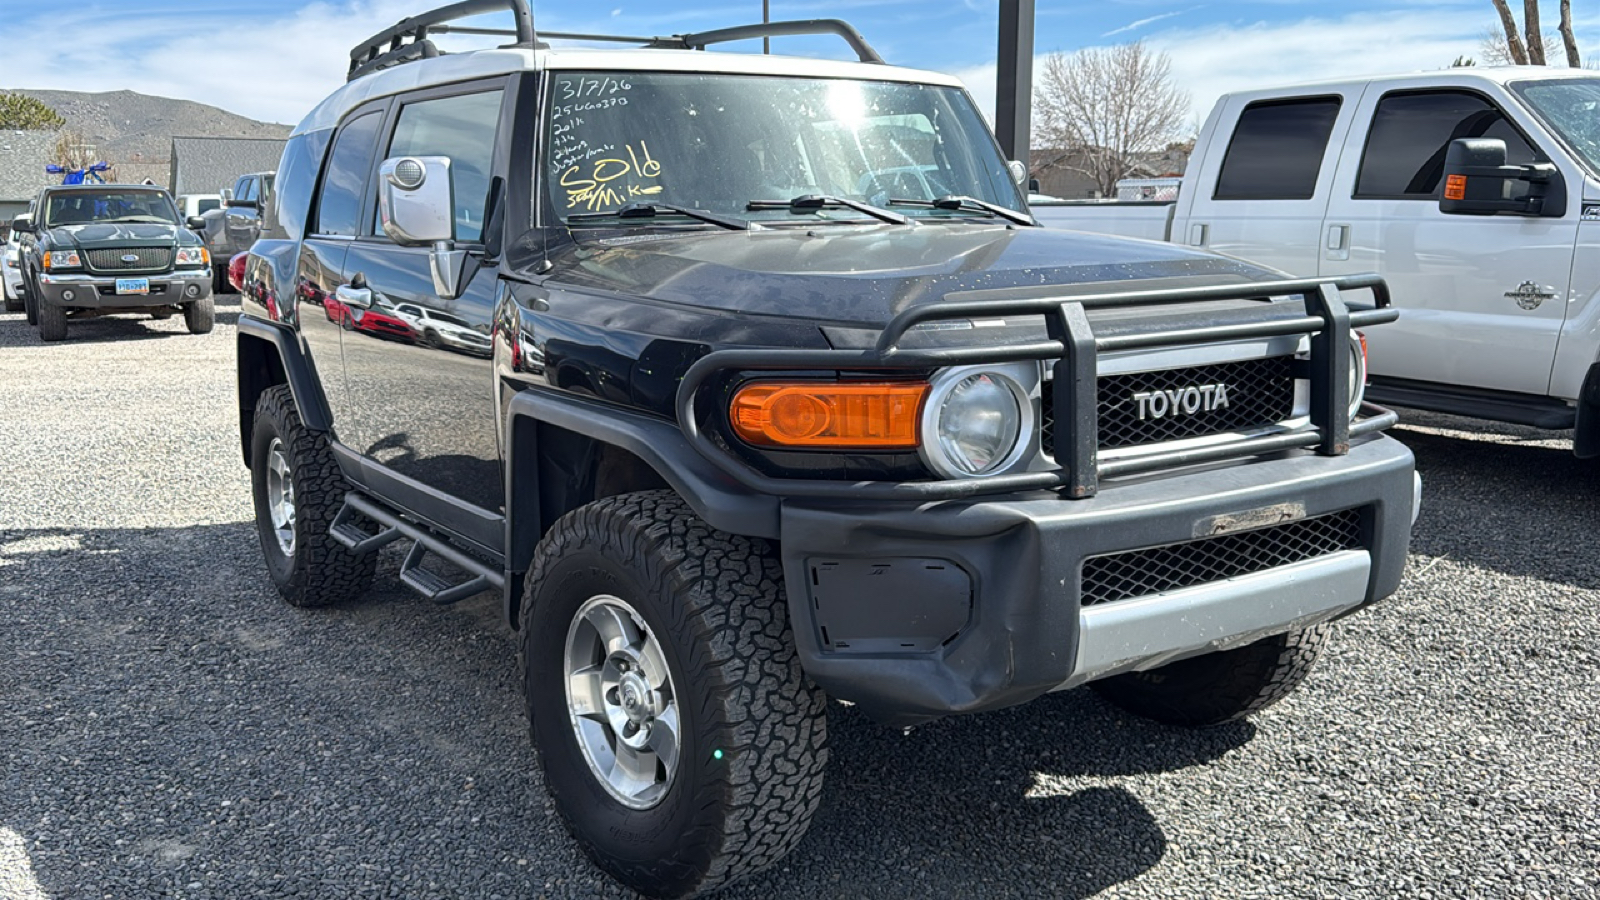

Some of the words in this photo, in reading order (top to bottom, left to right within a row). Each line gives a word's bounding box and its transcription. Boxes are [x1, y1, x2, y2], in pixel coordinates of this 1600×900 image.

[560, 77, 632, 100] 3/7/26
[560, 140, 661, 194] Sold
[1134, 383, 1230, 420] TOYOTA
